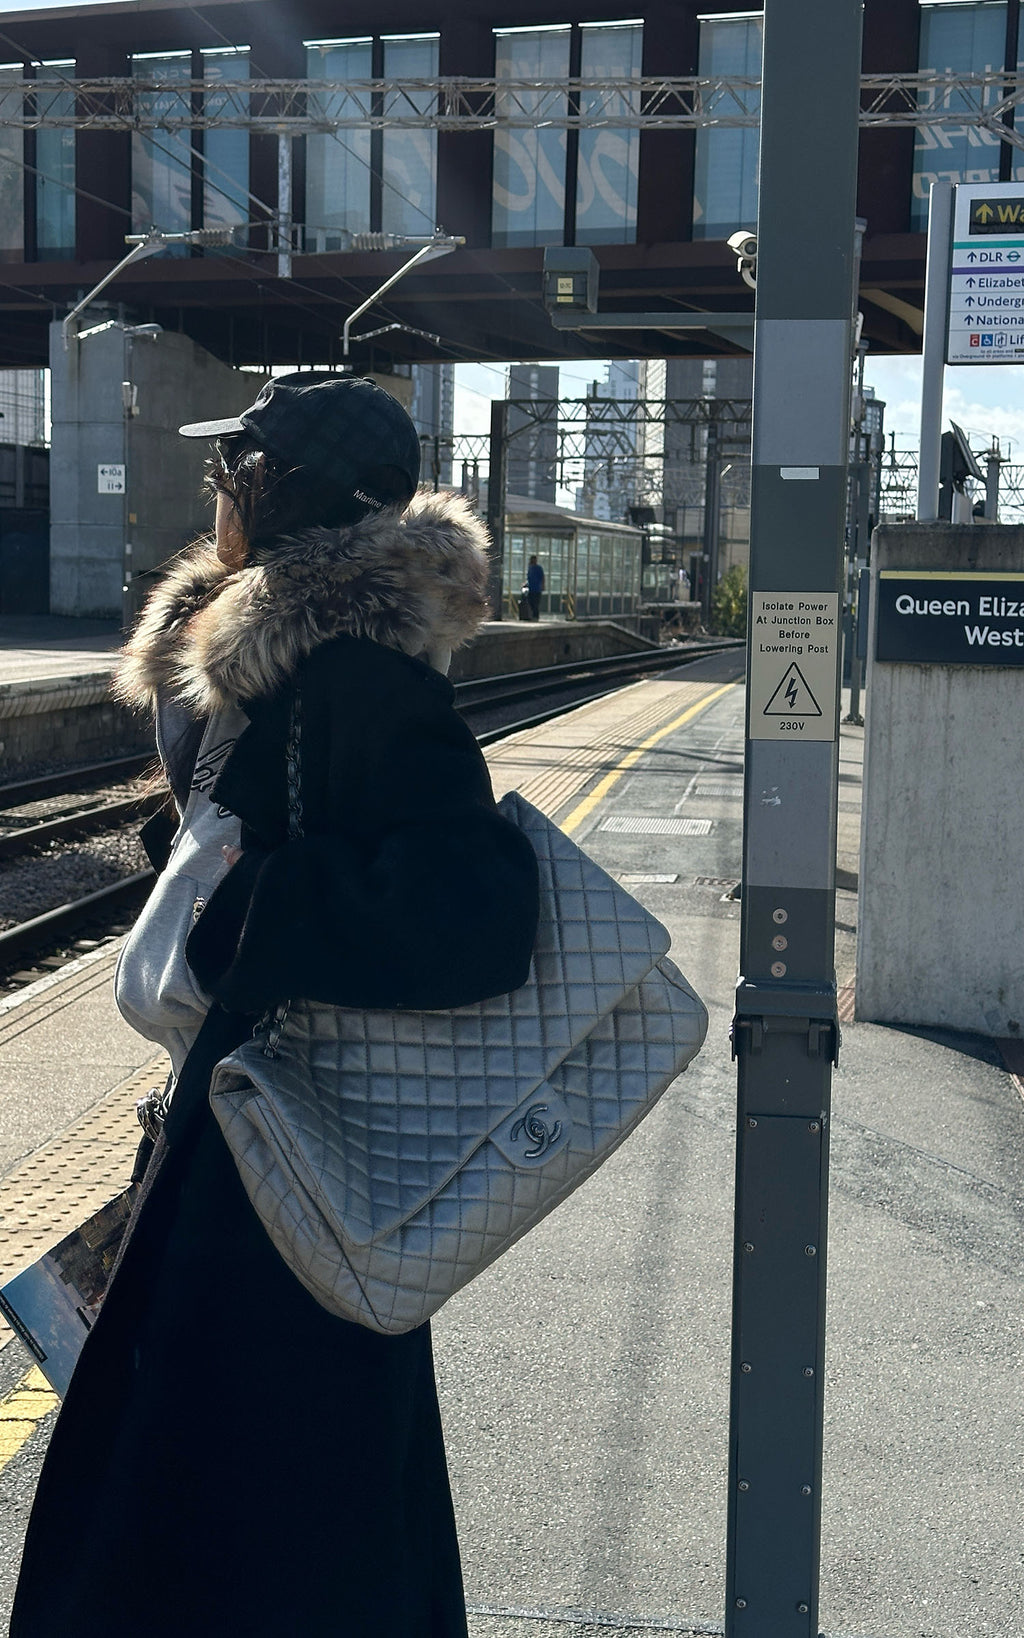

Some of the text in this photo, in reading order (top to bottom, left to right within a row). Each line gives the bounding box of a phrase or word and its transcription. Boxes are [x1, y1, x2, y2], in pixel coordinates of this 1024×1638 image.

[980, 252, 1003, 262] DLR
[353, 489, 382, 509] Martine
[762, 602, 828, 611] Isolate Power
[895, 594, 970, 616] Queen
[756, 616, 834, 625] At Junction Box
[779, 630, 810, 639] Before
[964, 625, 1024, 647] West
[759, 644, 829, 655] Lowering Post
[779, 722, 805, 731] 230V
